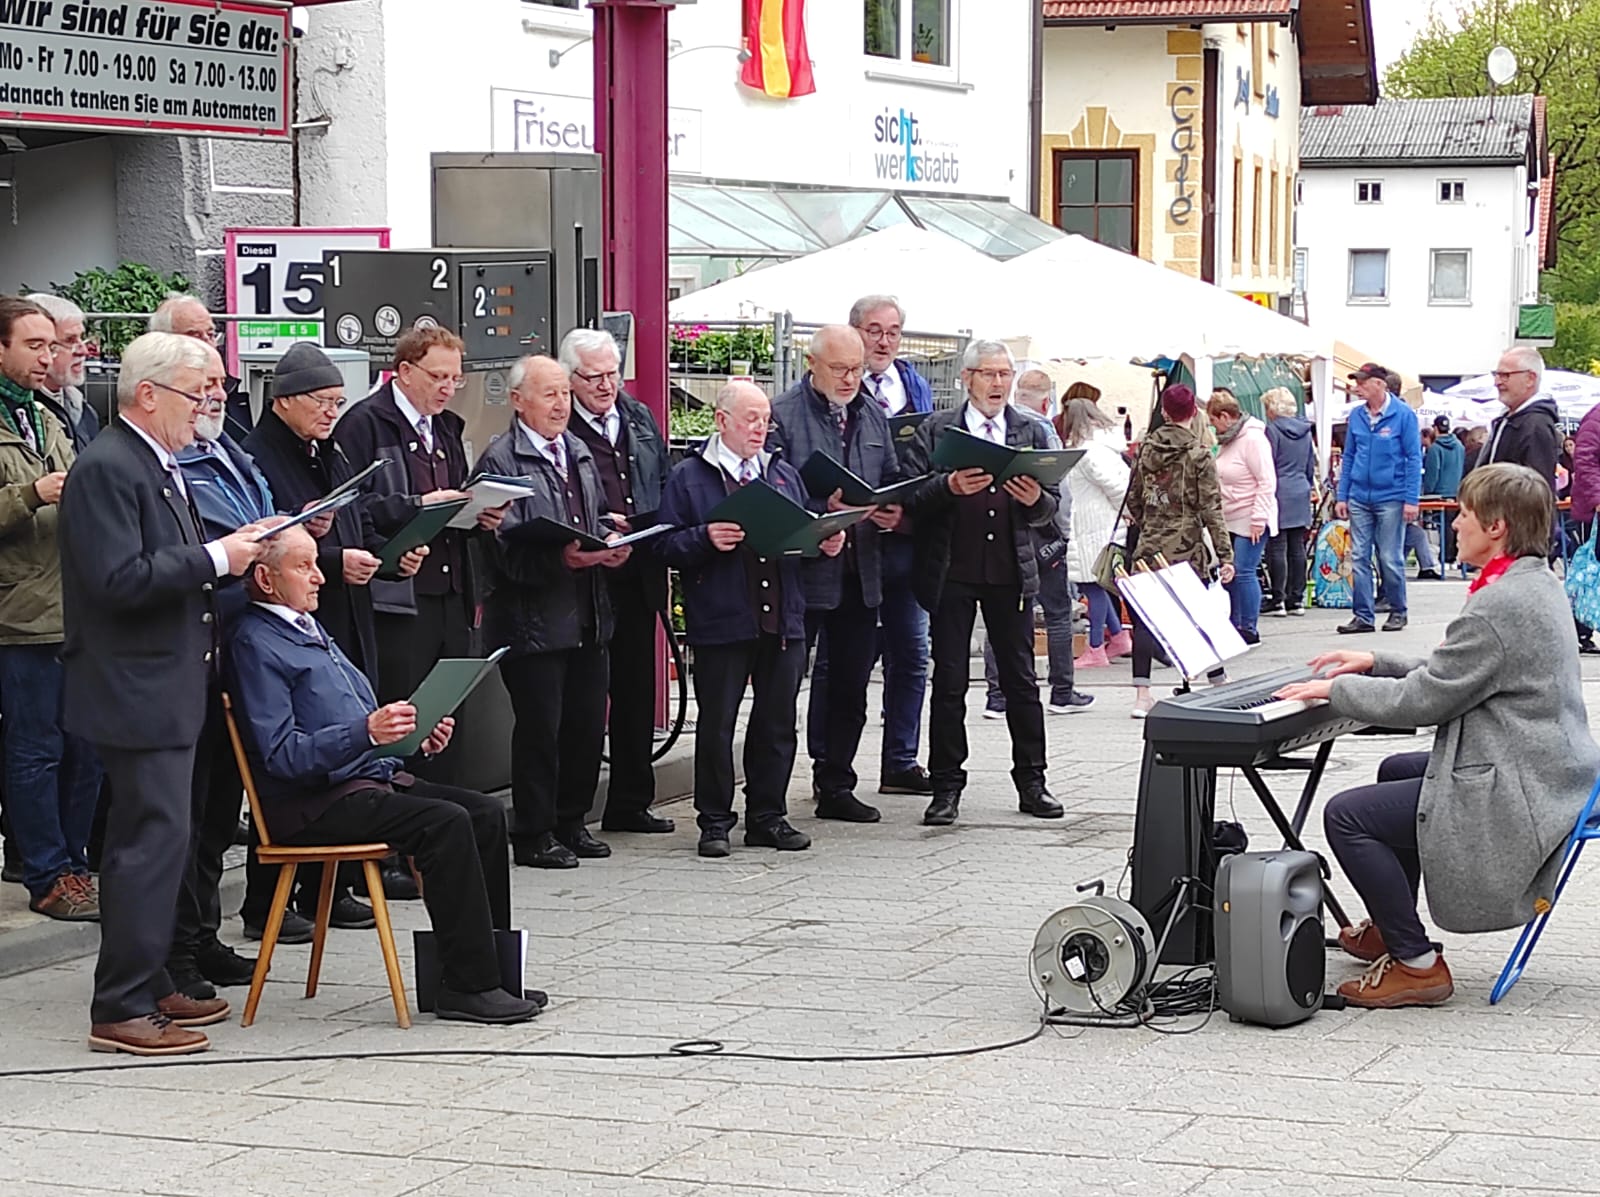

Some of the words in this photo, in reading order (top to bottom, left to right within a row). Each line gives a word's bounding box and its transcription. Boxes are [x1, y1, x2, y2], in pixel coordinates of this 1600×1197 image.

[0, 0, 53, 27] Wir
[60, 0, 128, 36] sind
[136, 6, 181, 41] für
[187, 14, 230, 47] Sie
[238, 20, 279, 52] da:
[0, 42, 22, 70] Mo
[38, 46, 54, 73] Fr
[63, 48, 99, 77] 7.00
[113, 53, 157, 82] 19.00
[169, 58, 186, 85] Sa
[194, 61, 226, 88] 7.00
[238, 65, 277, 93] 13.00
[0, 82, 64, 107] danach
[70, 88, 129, 111] tanken
[134, 93, 158, 114] Sie
[163, 99, 187, 116] am
[192, 99, 276, 122] Automaten
[513, 98, 594, 152] Friseu
[874, 150, 959, 184] werkstatt
[242, 246, 273, 255] Diesel
[329, 255, 340, 287] 1
[432, 258, 448, 289] 2
[475, 286, 486, 317] 2
[240, 323, 277, 336] Super
